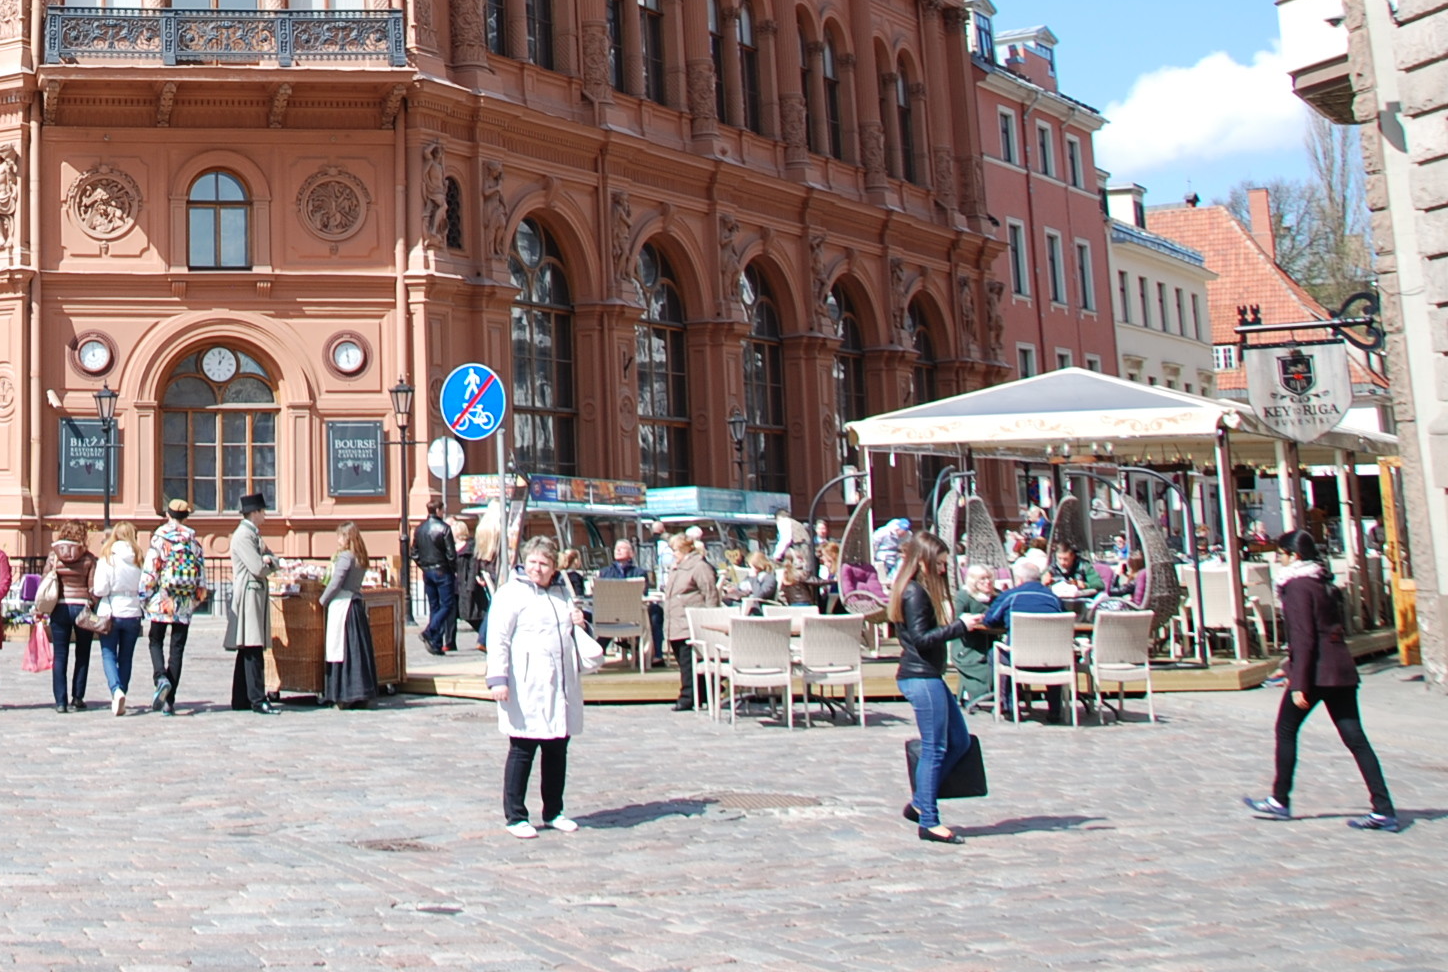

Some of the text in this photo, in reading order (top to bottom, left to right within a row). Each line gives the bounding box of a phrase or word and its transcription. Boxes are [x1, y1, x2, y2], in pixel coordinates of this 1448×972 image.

[1263, 406, 1291, 418] KEY
[1302, 403, 1341, 416] RIGA
[70, 435, 105, 447] BIRŽA
[334, 439, 377, 449] BOURSE
